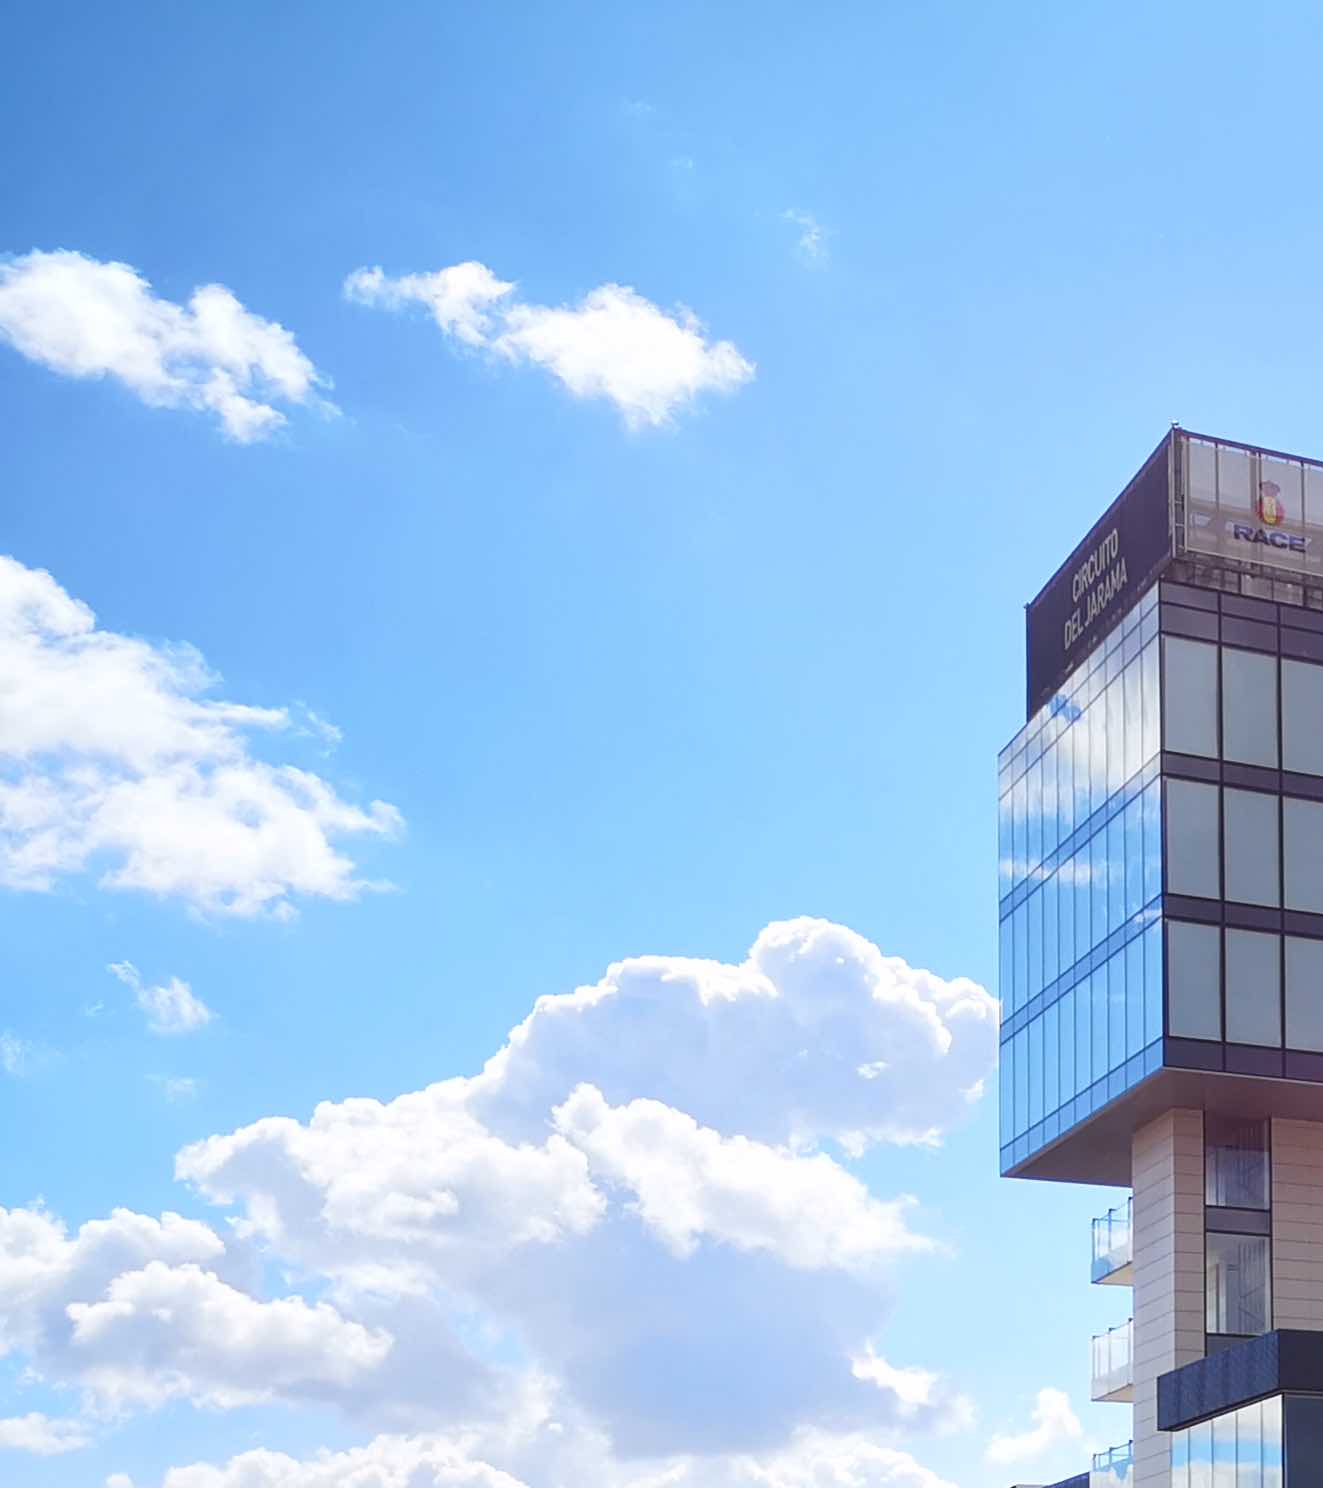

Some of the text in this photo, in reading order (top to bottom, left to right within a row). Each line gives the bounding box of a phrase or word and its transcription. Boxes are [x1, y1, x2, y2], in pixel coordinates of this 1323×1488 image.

[1072, 528, 1119, 602] CIRCUITO
[1233, 524, 1306, 553] RACE
[1064, 557, 1128, 650] DEL JARAMA
